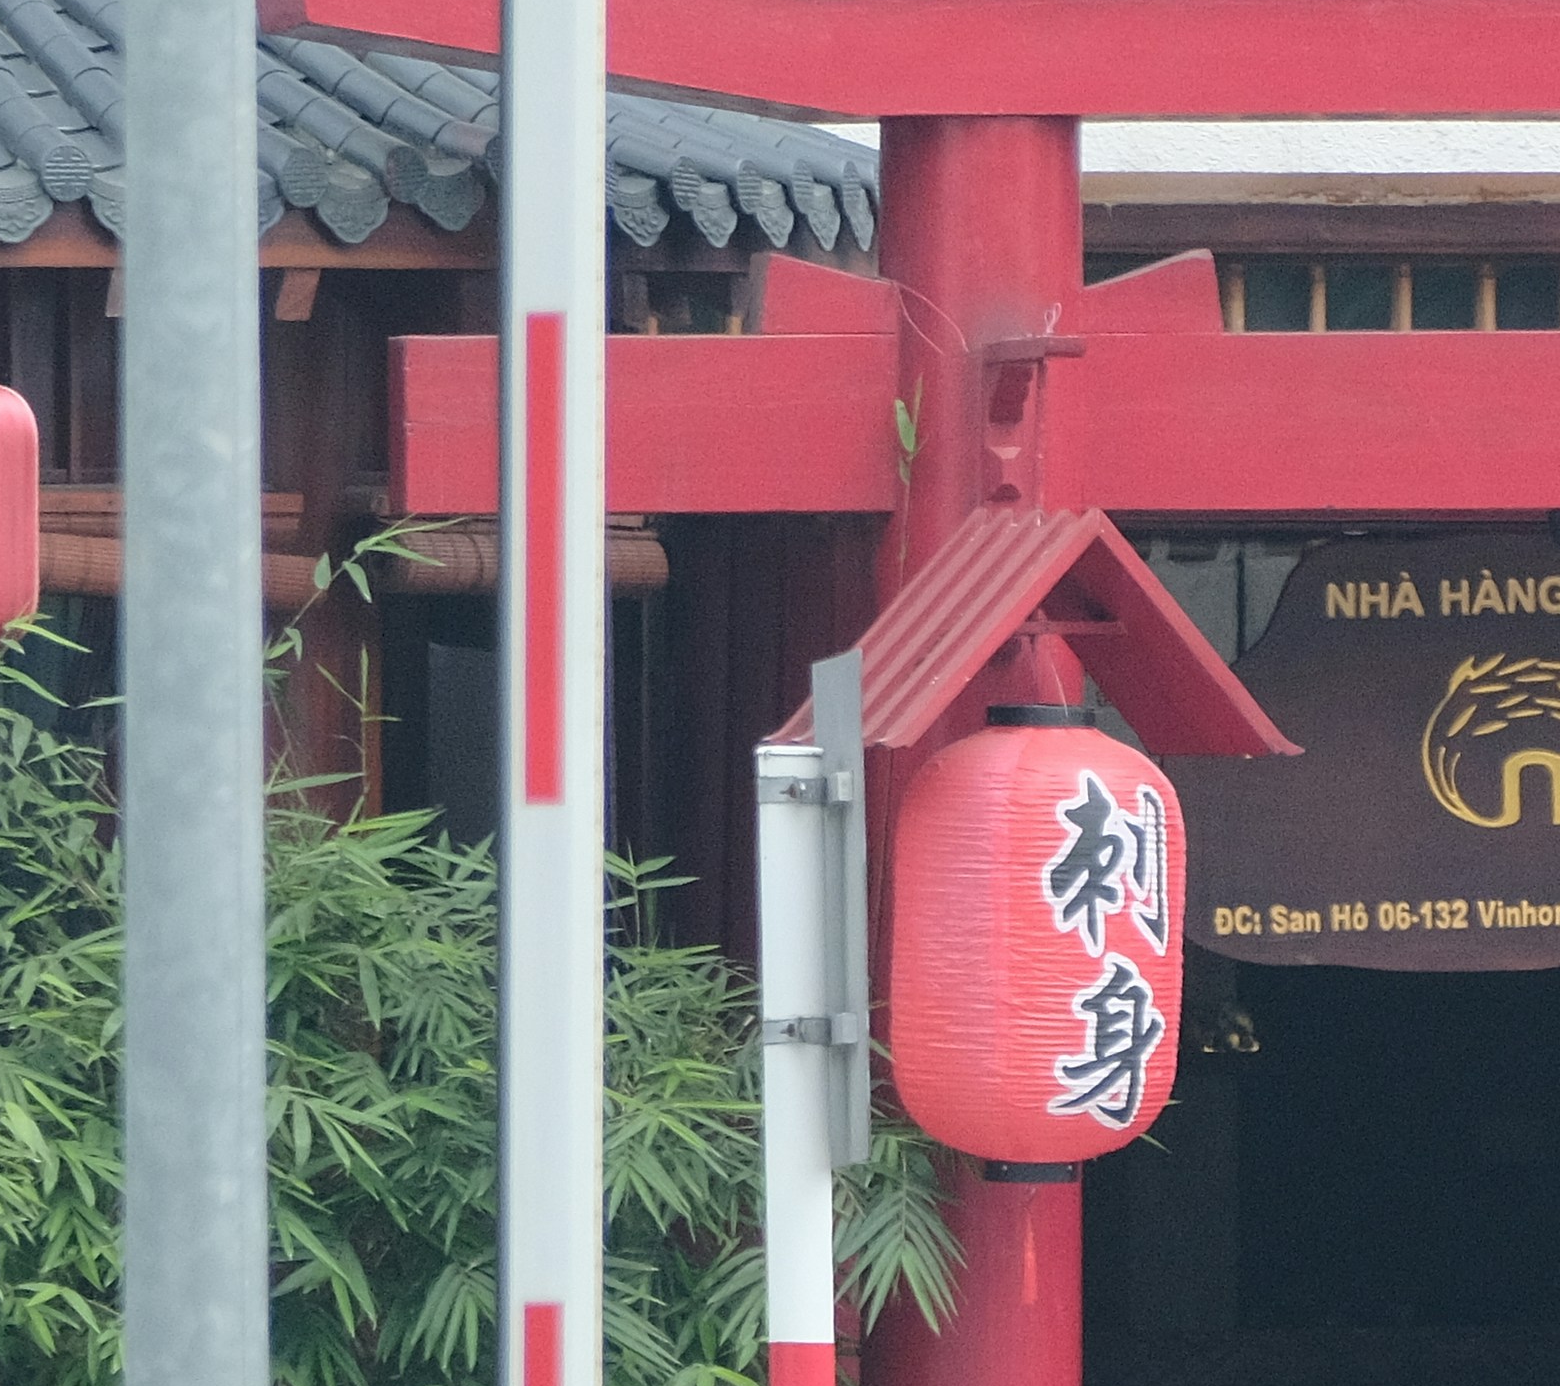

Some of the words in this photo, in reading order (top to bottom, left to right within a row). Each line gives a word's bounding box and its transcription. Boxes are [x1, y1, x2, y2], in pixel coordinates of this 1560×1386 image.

[1325, 570, 1425, 619] NHÀ
[1213, 905, 1263, 936] ĐC:
[1269, 904, 1322, 934] San
[1330, 901, 1370, 932] Hô
[1378, 898, 1470, 932] 06-132
[1042, 769, 1169, 1131] 刺身
